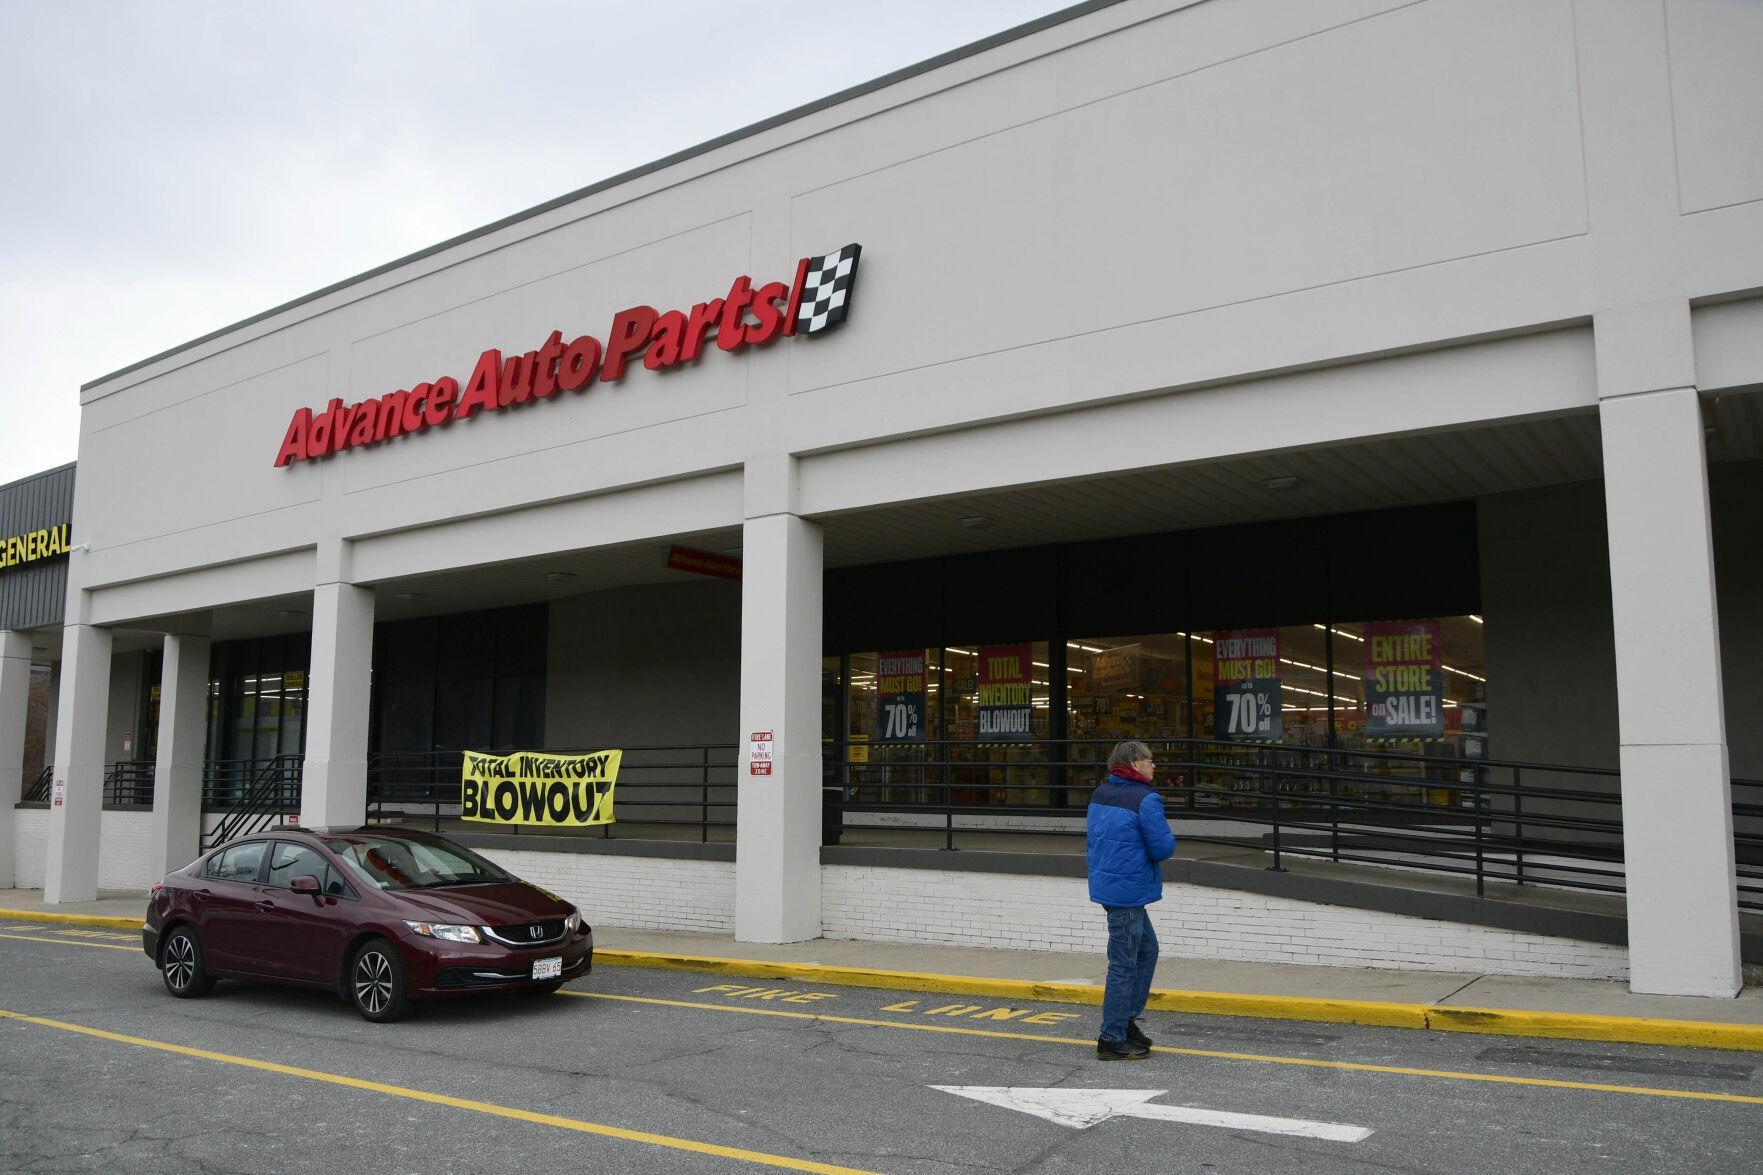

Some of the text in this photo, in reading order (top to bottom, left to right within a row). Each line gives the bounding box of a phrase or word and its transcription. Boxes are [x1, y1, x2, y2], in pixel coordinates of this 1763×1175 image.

[273, 275, 789, 467] Advance Auto Parts
[1216, 637, 1276, 659] EVERYTHING
[1371, 634, 1433, 662] ENTIRE
[879, 656, 923, 675] EVERYTHING
[987, 656, 1025, 680] TOTAL
[1218, 658, 1276, 680] MUST GO!
[880, 674, 922, 693] MUST GO!
[1375, 665, 1433, 692] STORE
[979, 682, 1032, 706] INVENTORY
[885, 704, 918, 738] 70%
[979, 709, 1031, 733] BLOWOUT
[1226, 693, 1271, 733] 70%
[1372, 703, 1386, 716] on
[1385, 696, 1437, 725] SALE!
[1259, 717, 1271, 731] off
[757, 743, 766, 751] NO
[469, 755, 610, 779] TOTAL INVENTORY
[463, 779, 613, 823] BLOWOUT
